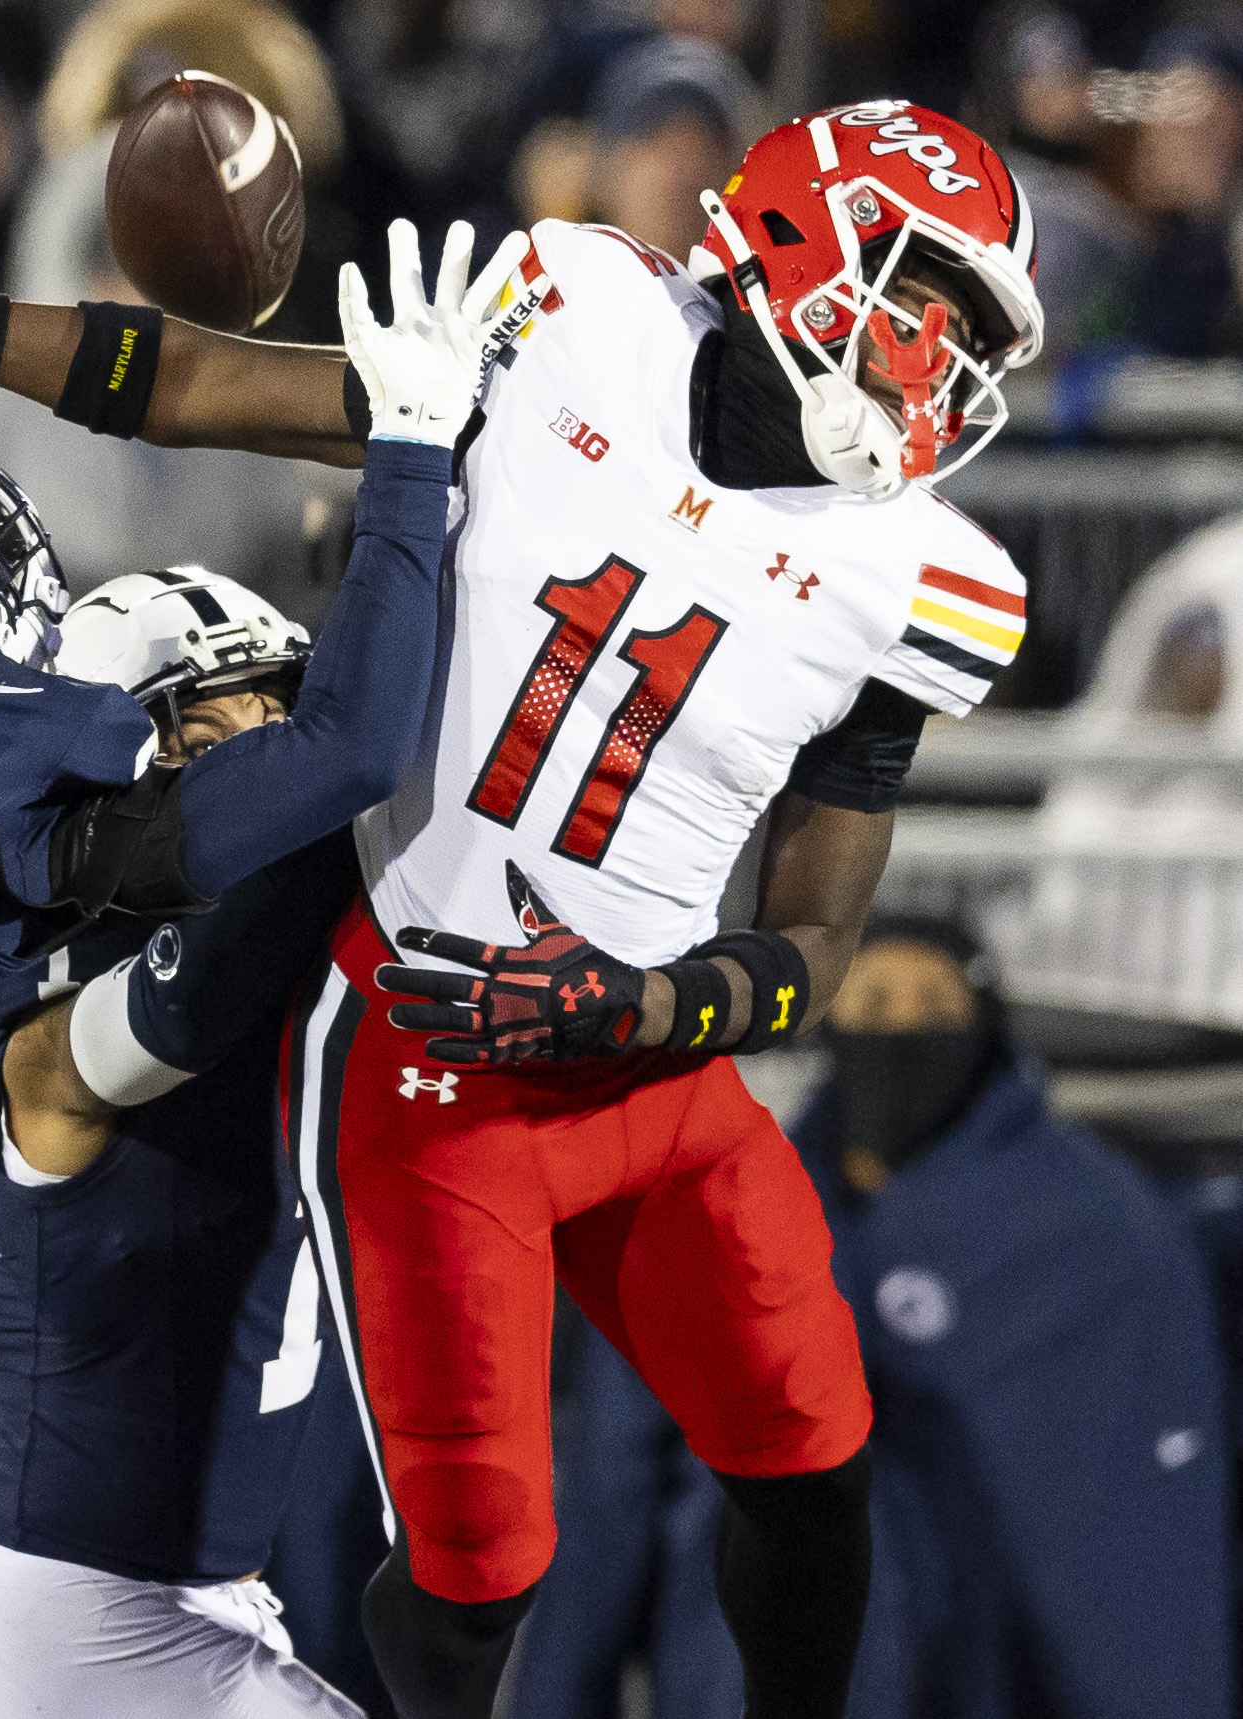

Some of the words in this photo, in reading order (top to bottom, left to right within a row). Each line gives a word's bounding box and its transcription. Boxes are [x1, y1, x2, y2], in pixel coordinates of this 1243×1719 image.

[490, 289, 542, 346] PENN
[108, 329, 138, 391] MARYLAND
[671, 484, 715, 530] M
[464, 552, 730, 870] 11
